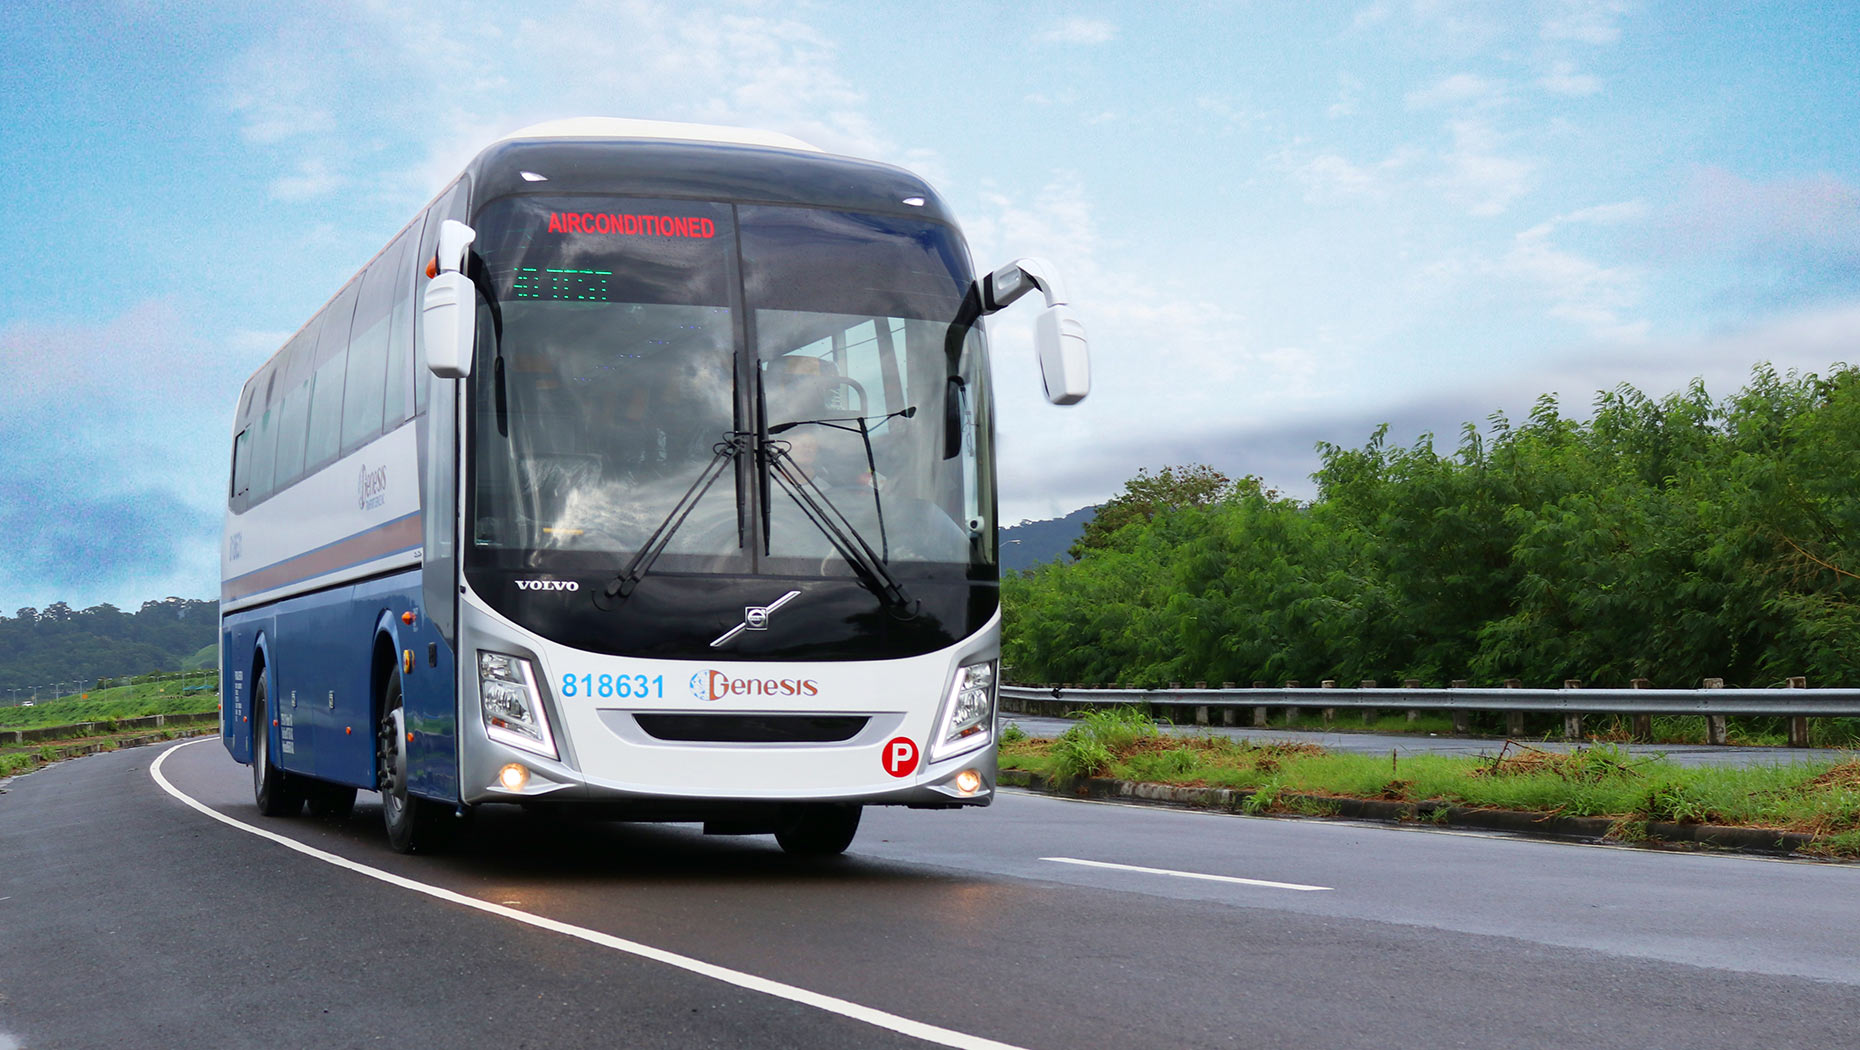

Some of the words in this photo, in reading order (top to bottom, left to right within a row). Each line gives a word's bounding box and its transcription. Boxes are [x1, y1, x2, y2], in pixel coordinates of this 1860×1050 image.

[548, 212, 715, 239] AIRCONDITIONED
[514, 580, 579, 592] VOLVO
[561, 673, 664, 698] 818631
[891, 743, 913, 772] P
